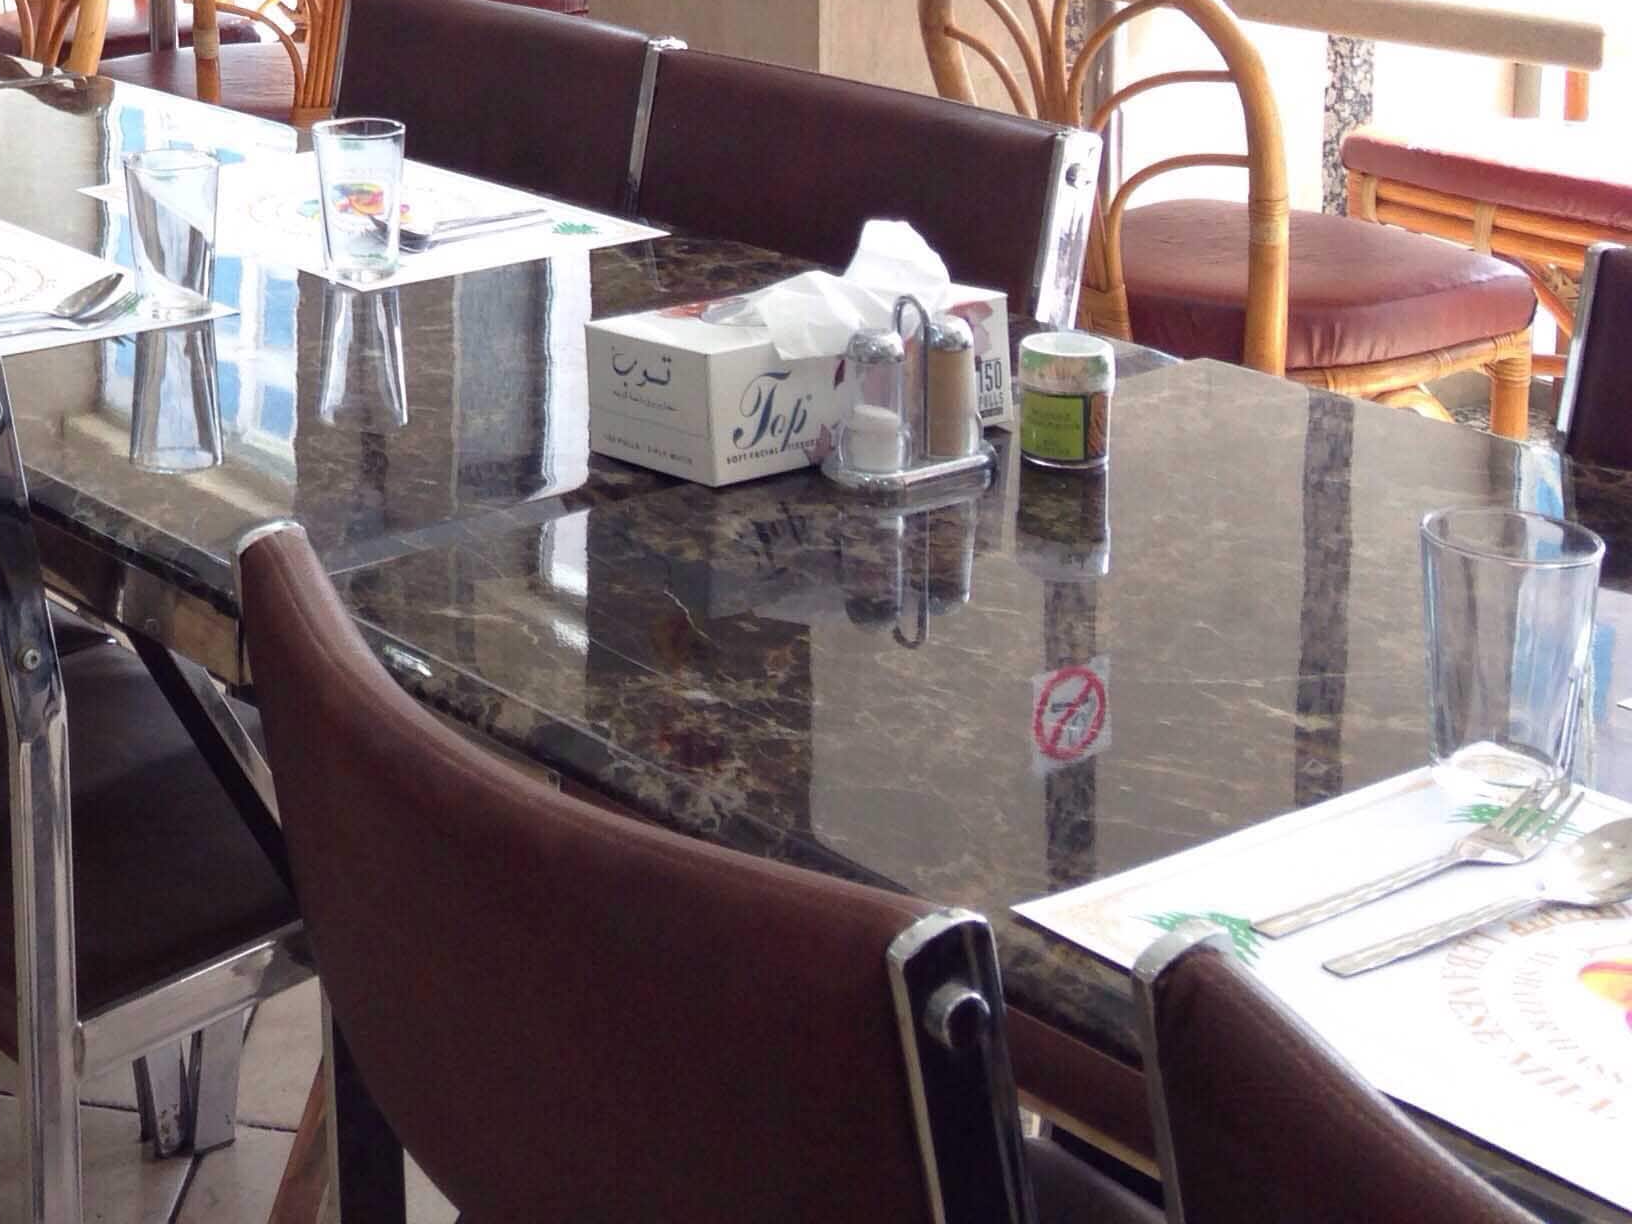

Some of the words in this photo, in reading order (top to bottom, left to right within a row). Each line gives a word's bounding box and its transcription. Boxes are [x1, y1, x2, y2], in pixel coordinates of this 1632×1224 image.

[978, 361, 1002, 393] 150
[732, 369, 807, 452] Top
[726, 453, 747, 465] SOFT
[749, 447, 779, 460] FACIAL
